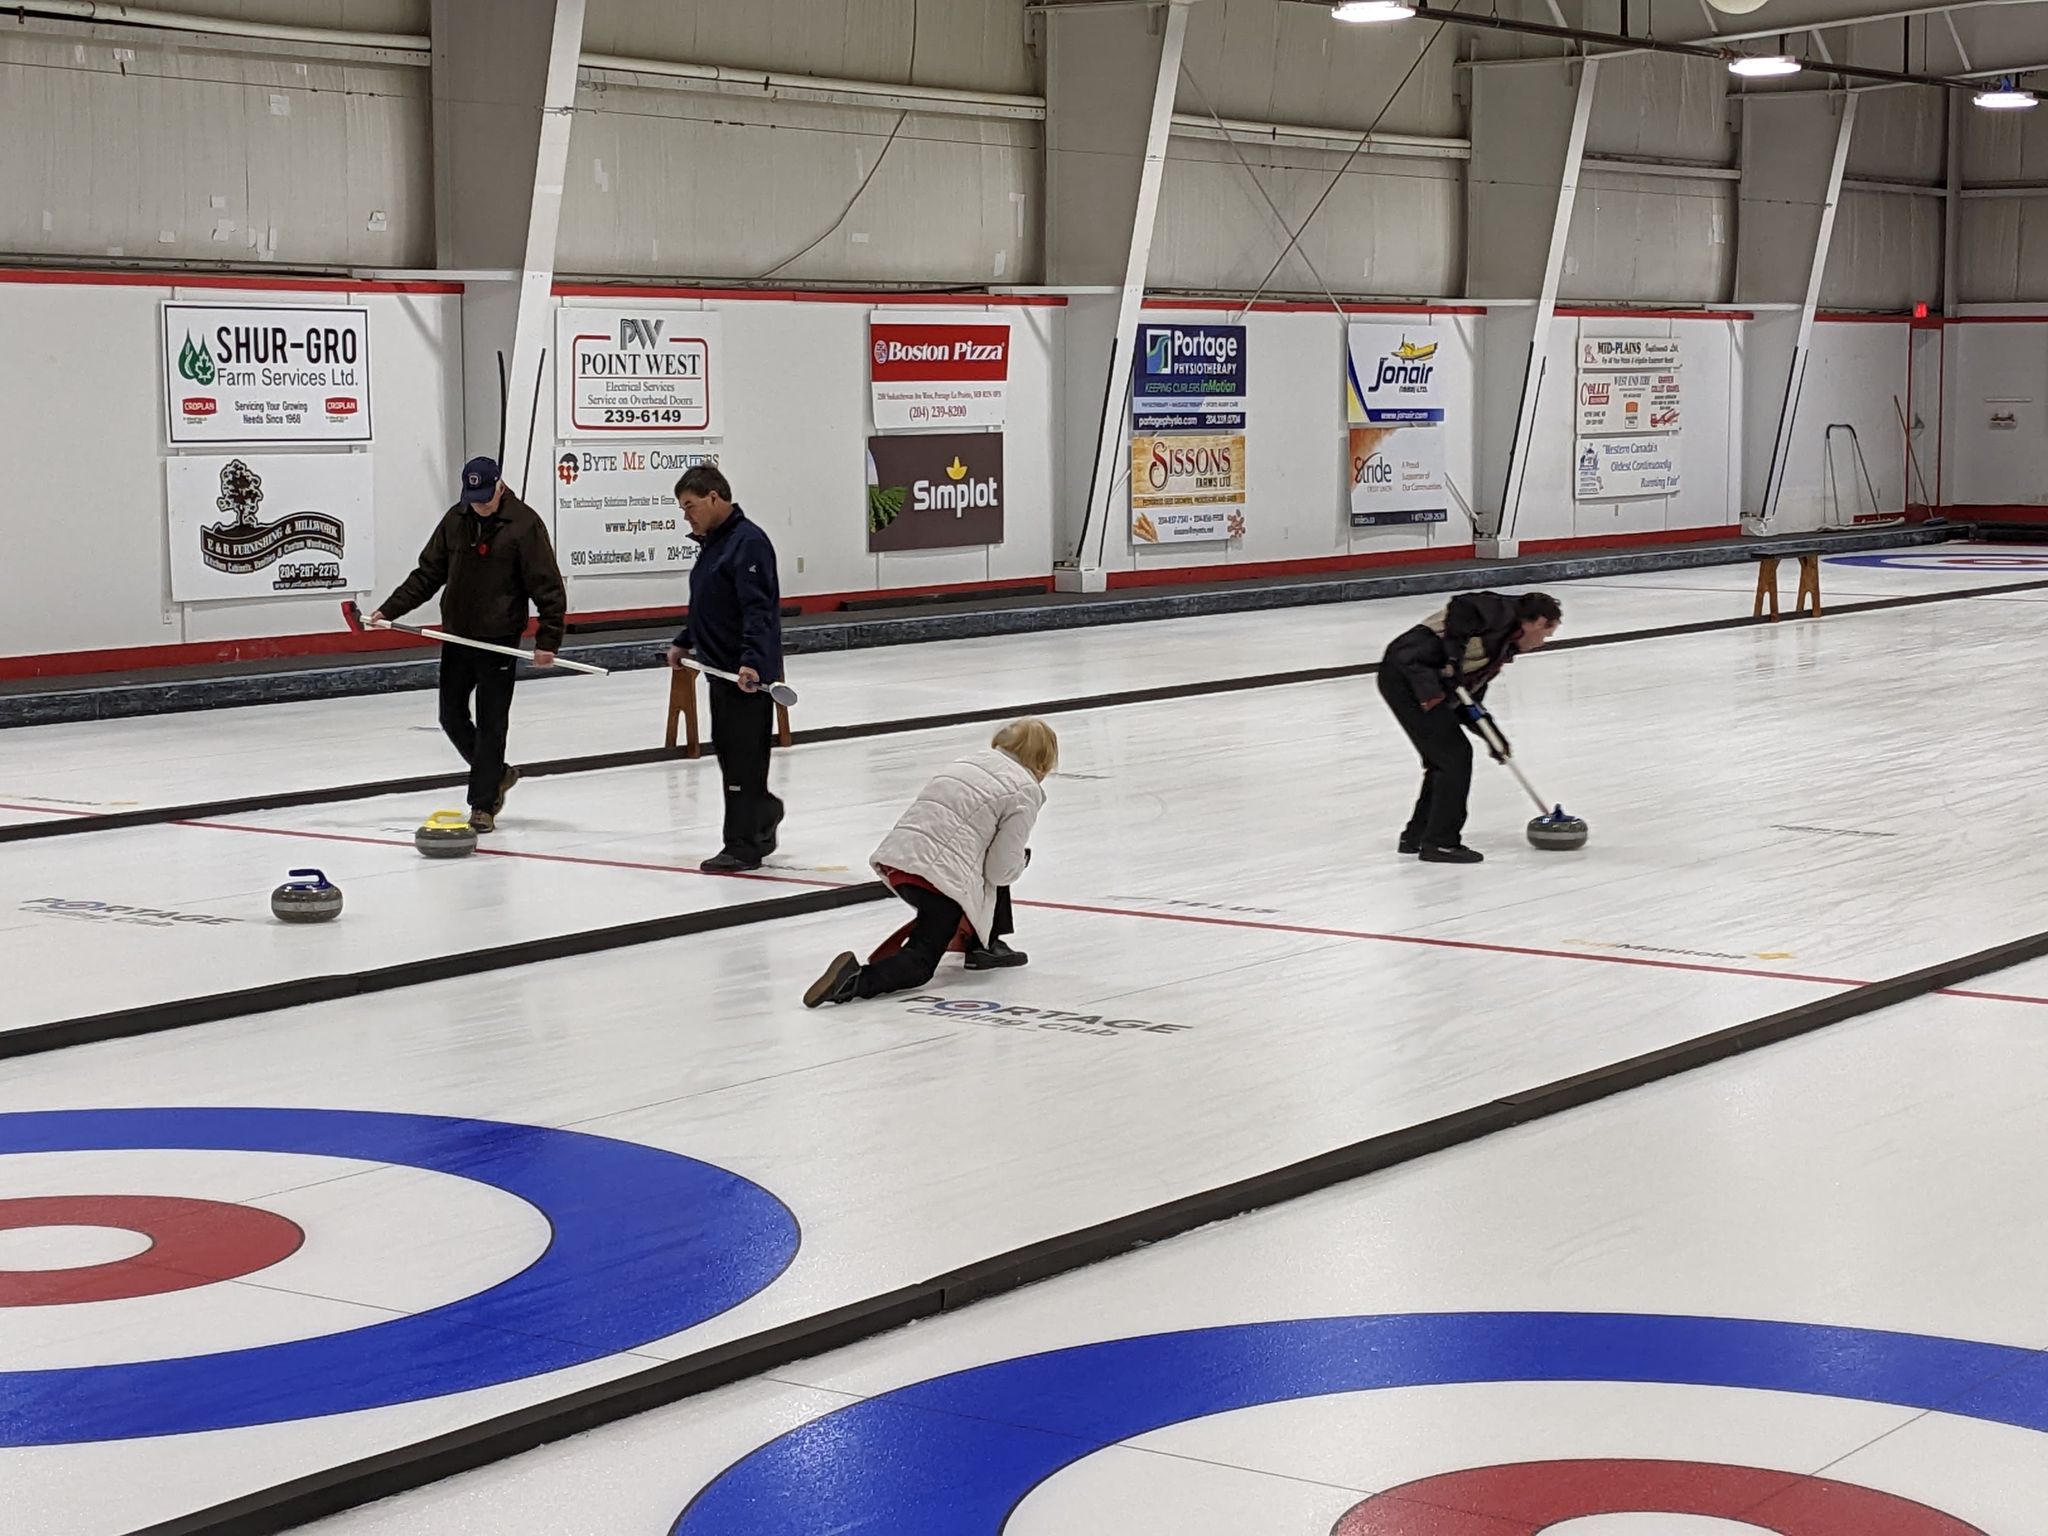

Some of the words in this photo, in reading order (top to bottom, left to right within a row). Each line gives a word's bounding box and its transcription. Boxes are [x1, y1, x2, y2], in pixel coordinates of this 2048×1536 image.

[216, 326, 357, 364] SHUR-GRO
[888, 341, 949, 361] Boston
[954, 340, 1002, 361] Pizza
[1174, 330, 1238, 362] Portage
[1597, 341, 1641, 354] MID-PLAINS
[581, 353, 641, 375] POINT
[646, 354, 700, 375] WEST
[1174, 363, 1237, 374] PHYSIOTHERAPY
[217, 368, 256, 386] Farm
[261, 368, 326, 386] Services
[331, 368, 359, 386] Ltd.
[1368, 357, 1433, 392] Jonair
[606, 381, 641, 392] Electrical
[643, 381, 675, 392] Services
[184, 402, 215, 411] CROPLAN
[234, 400, 265, 413] Servicing
[267, 401, 280, 411] Your
[282, 401, 308, 413] Growing
[588, 395, 616, 405] Service
[618, 397, 628, 405] on
[630, 395, 667, 405] Overhead
[669, 396, 693, 405] Doors
[243, 414, 264, 424] Needs
[265, 414, 284, 424] Since
[604, 410, 681, 423] 239-6149
[582, 452, 617, 471] BYTE
[1149, 441, 1232, 491] SISSONS
[913, 477, 999, 518] Simplot
[605, 519, 676, 534] www.byte-me.ca
[588, 549, 632, 565] Saskatchewan
[648, 547, 655, 561] W
[898, 995, 1194, 1034] PORTAGE
[906, 1007, 1031, 1027] Curling
[1038, 1023, 1121, 1037] Club
